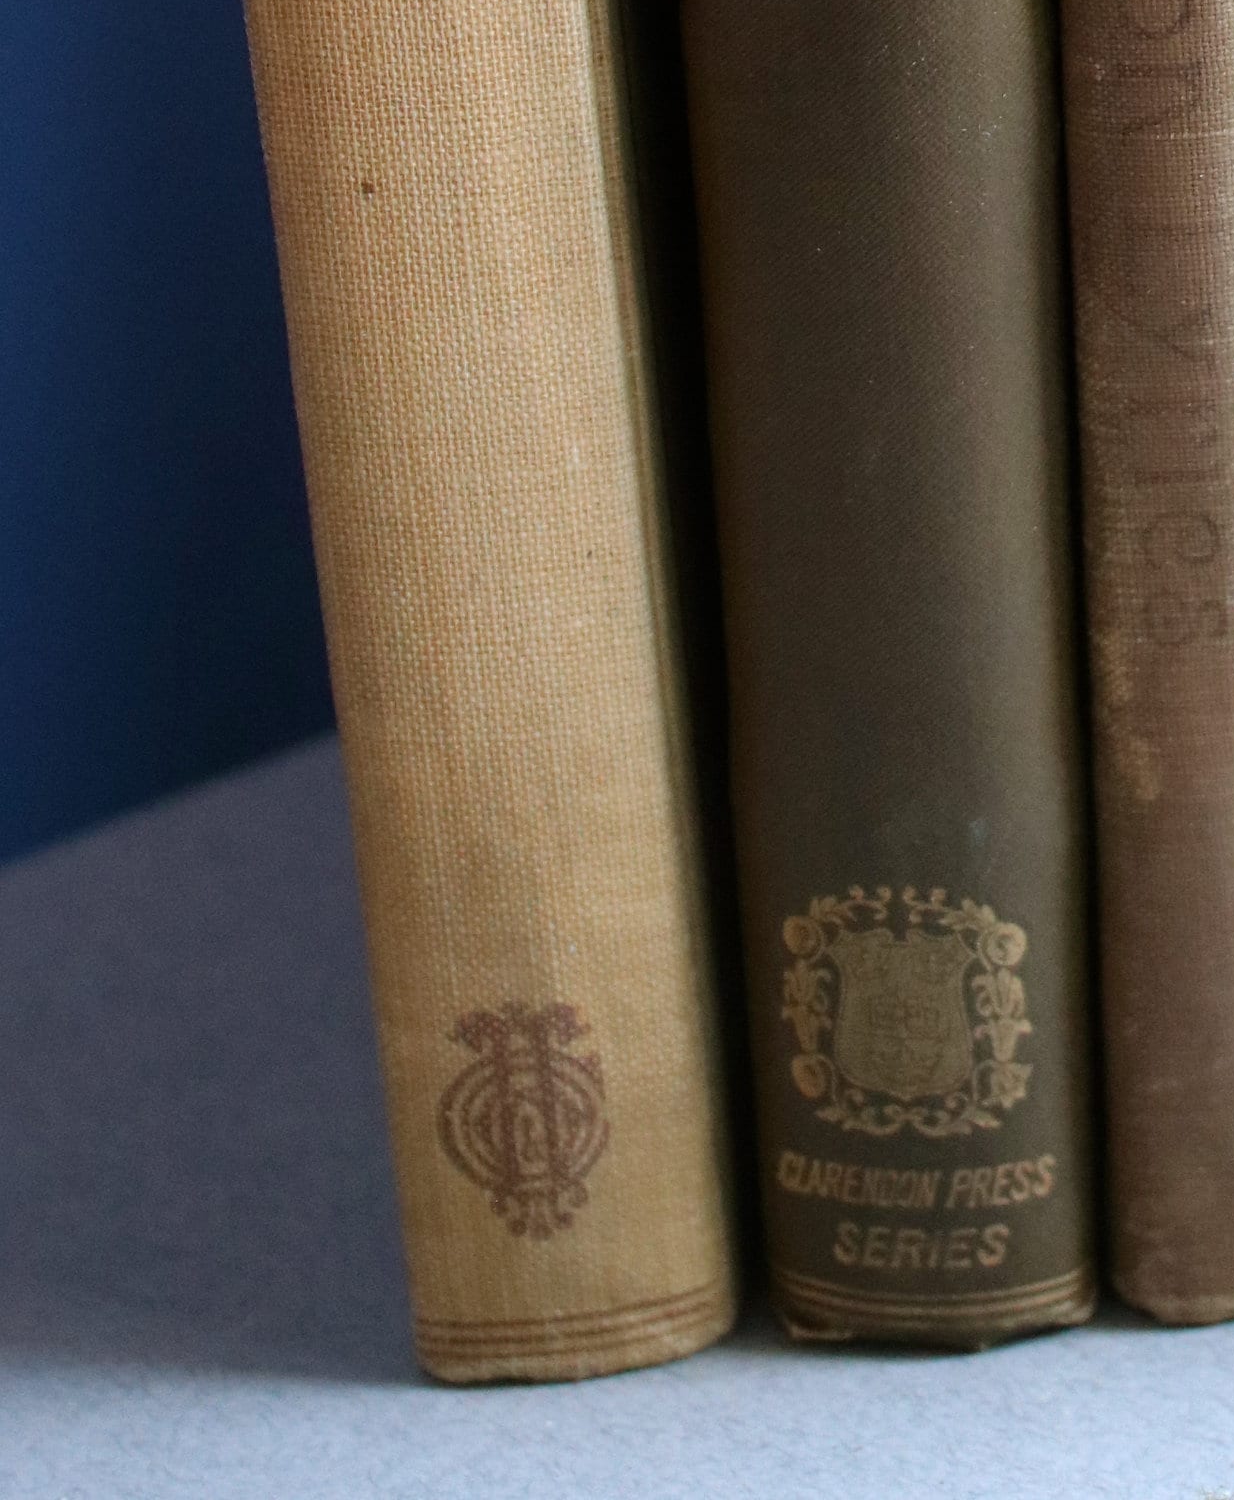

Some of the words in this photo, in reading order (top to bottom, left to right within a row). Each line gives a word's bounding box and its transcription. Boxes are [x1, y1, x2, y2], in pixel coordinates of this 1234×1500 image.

[777, 1151, 940, 1208] CLARENDON
[945, 1153, 1057, 1208] PRESS
[833, 1221, 1010, 1269] SERIES
